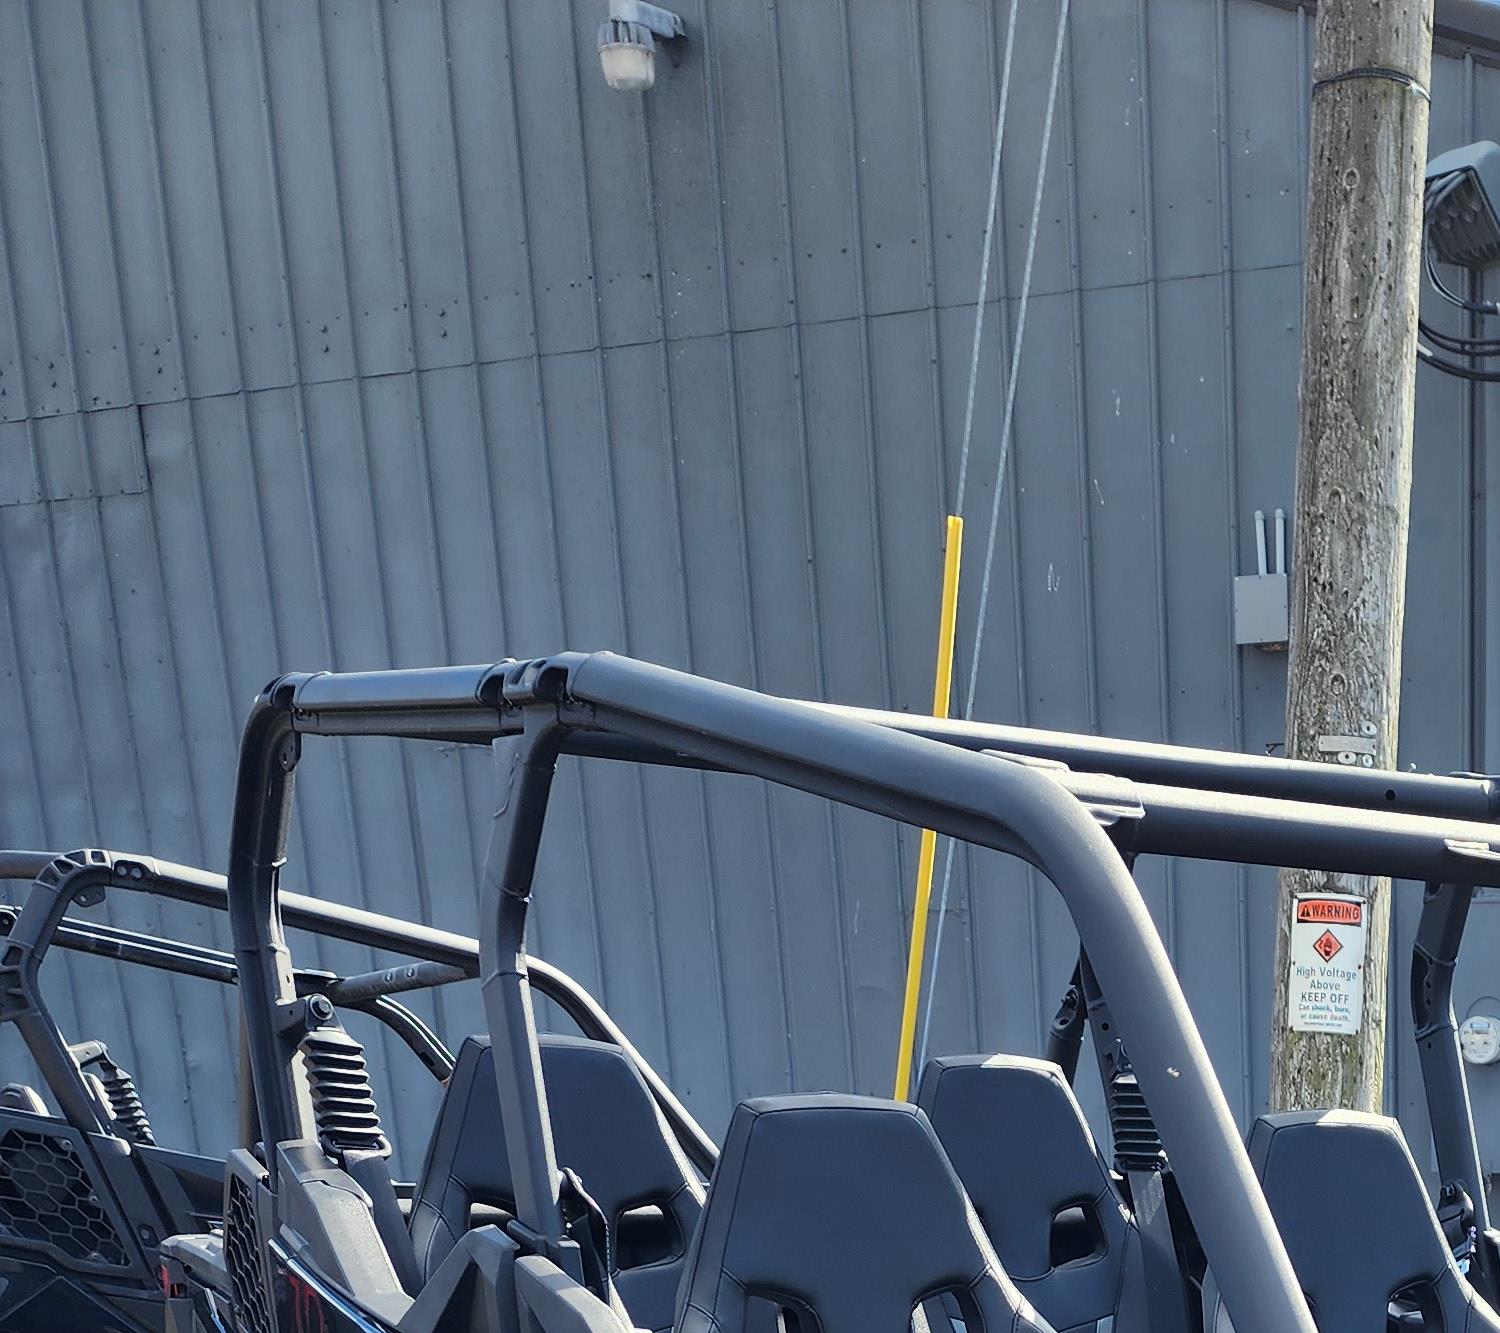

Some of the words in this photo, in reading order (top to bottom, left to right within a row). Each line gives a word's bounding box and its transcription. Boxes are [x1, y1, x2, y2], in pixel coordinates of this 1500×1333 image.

[1311, 904, 1361, 920] WARNING
[1296, 967, 1316, 979] High
[1320, 967, 1357, 981] Voltage
[1310, 980, 1341, 990] Above
[1301, 992, 1326, 1003] KEEP
[1330, 993, 1350, 1005] OFF
